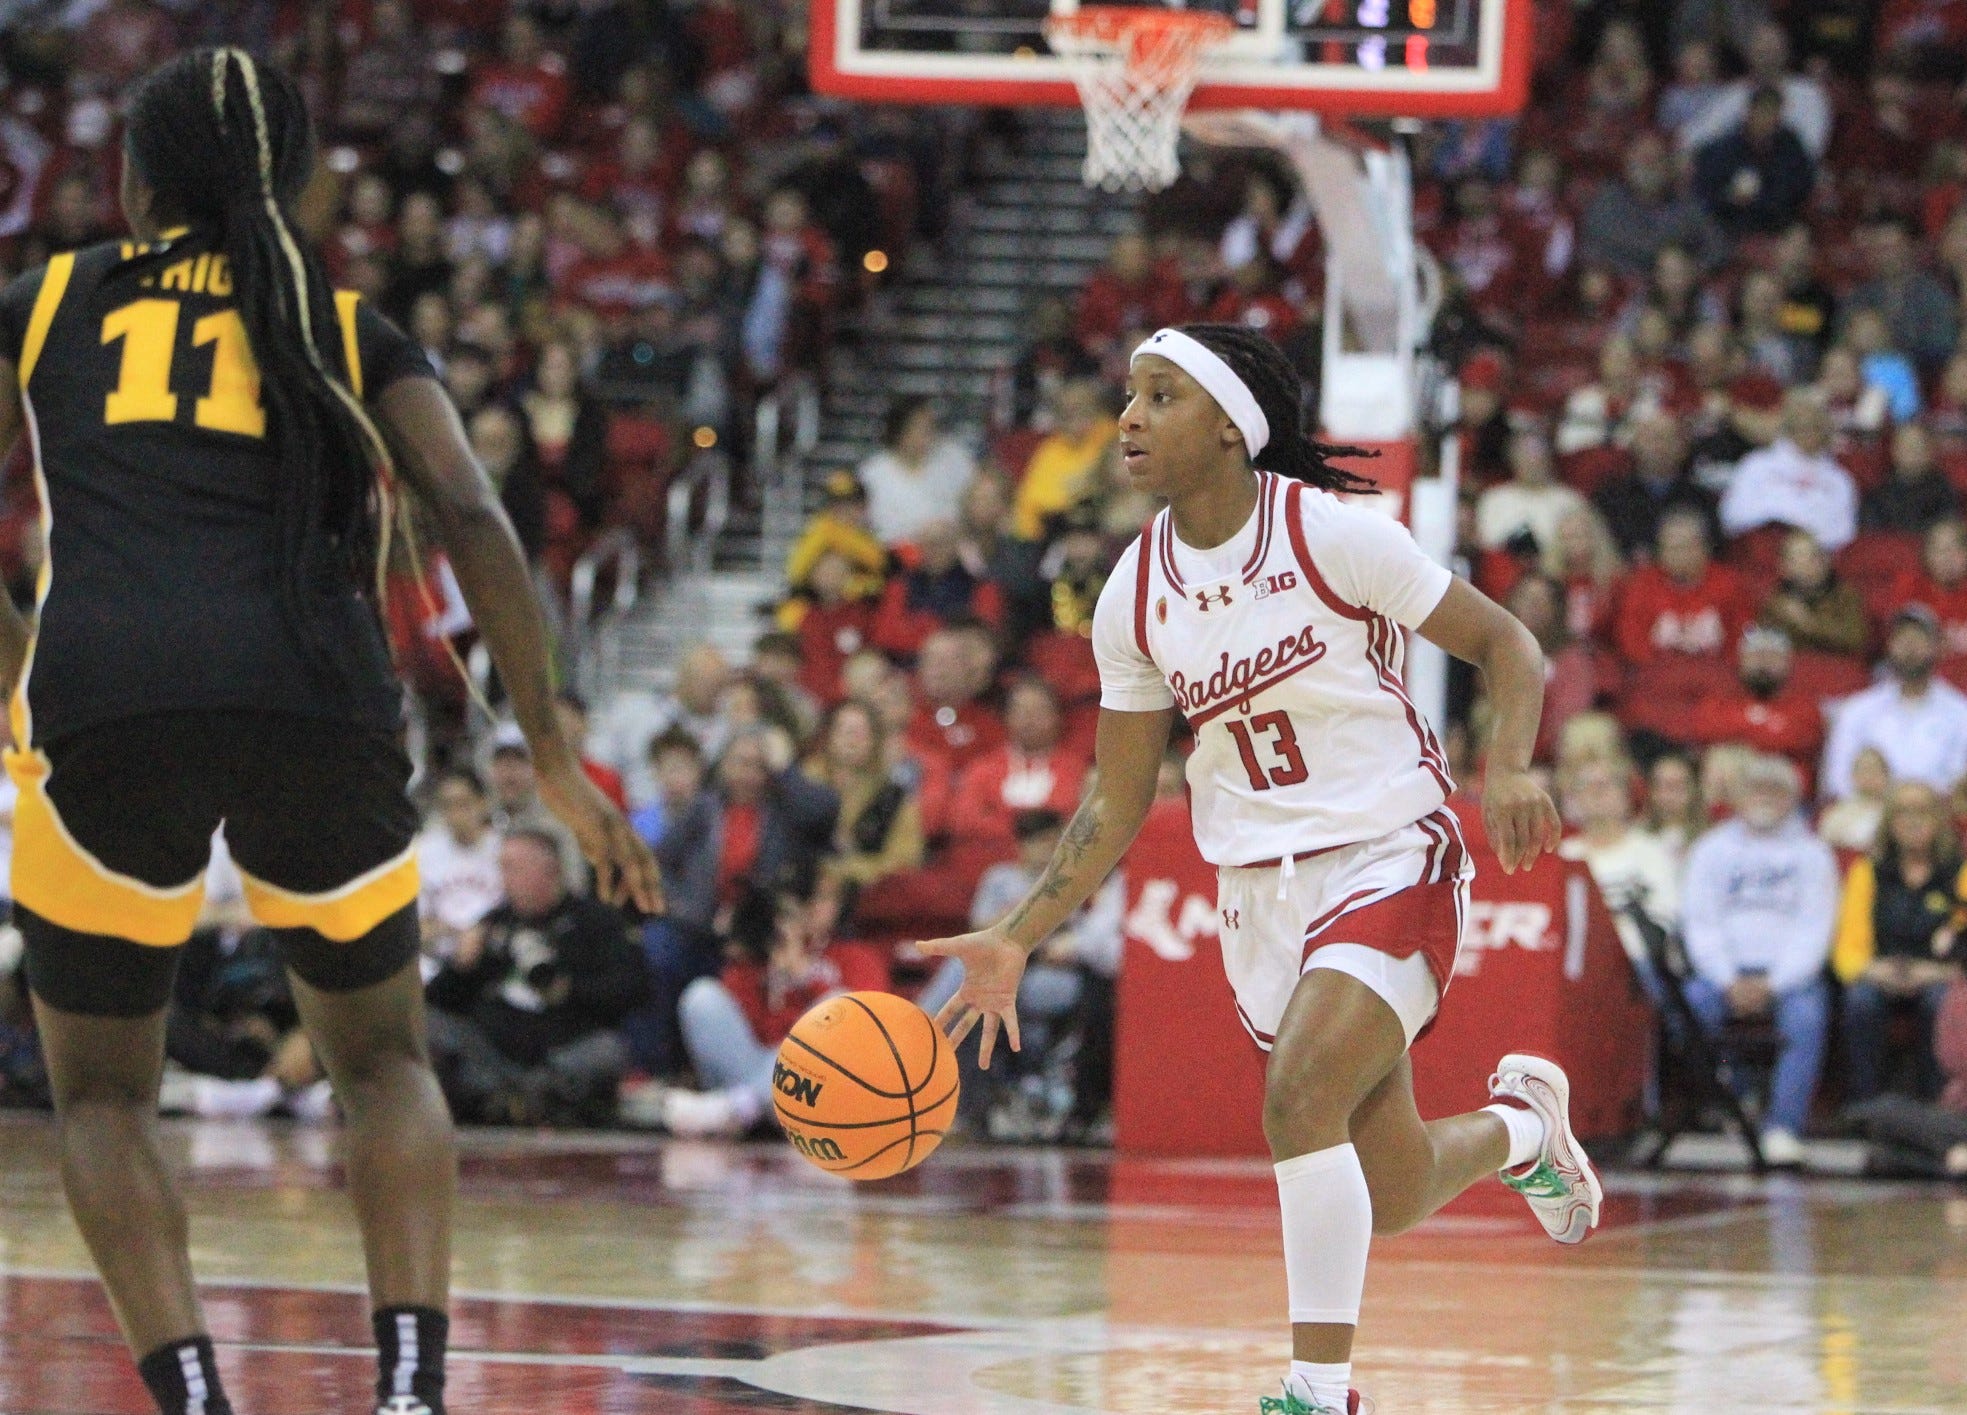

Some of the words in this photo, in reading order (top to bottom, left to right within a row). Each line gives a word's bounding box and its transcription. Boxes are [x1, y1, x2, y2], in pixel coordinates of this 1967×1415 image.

[101, 299, 266, 440] 11
[1168, 624, 1324, 716] Badgers
[1224, 708, 1310, 792] 13
